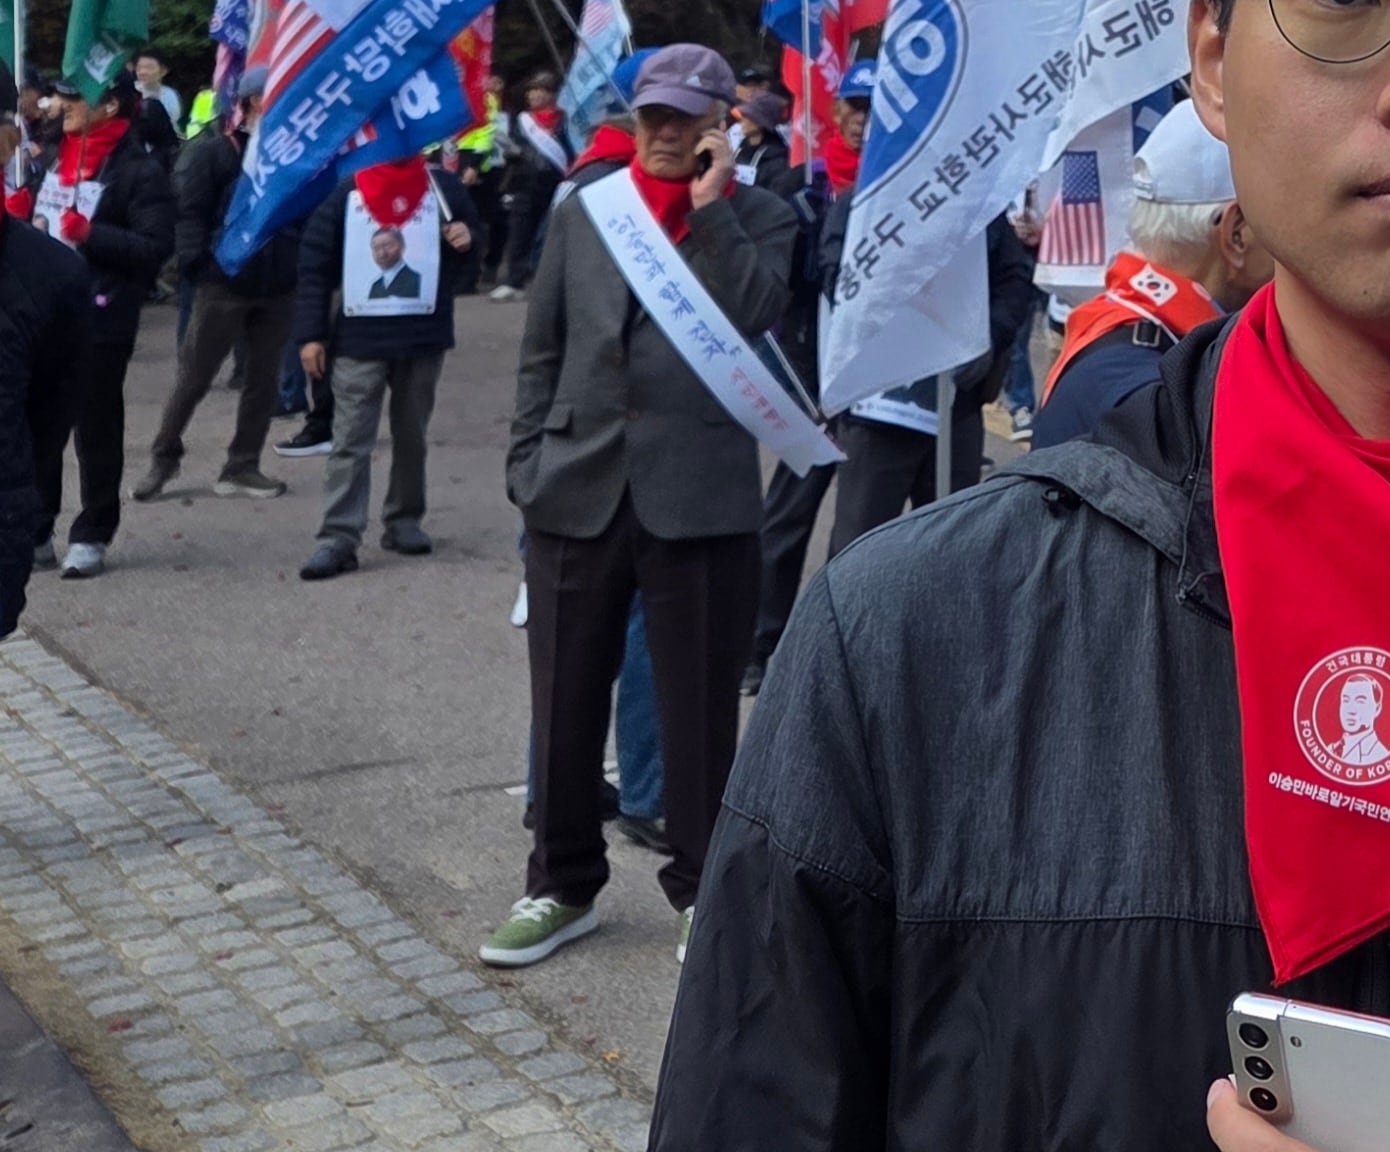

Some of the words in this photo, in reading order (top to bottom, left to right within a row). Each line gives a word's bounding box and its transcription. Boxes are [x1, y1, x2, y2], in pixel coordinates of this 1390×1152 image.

[1325, 652, 1387, 674] 건국대통령
[1299, 719, 1343, 776] FOUNDER
[1345, 767, 1365, 779] OF
